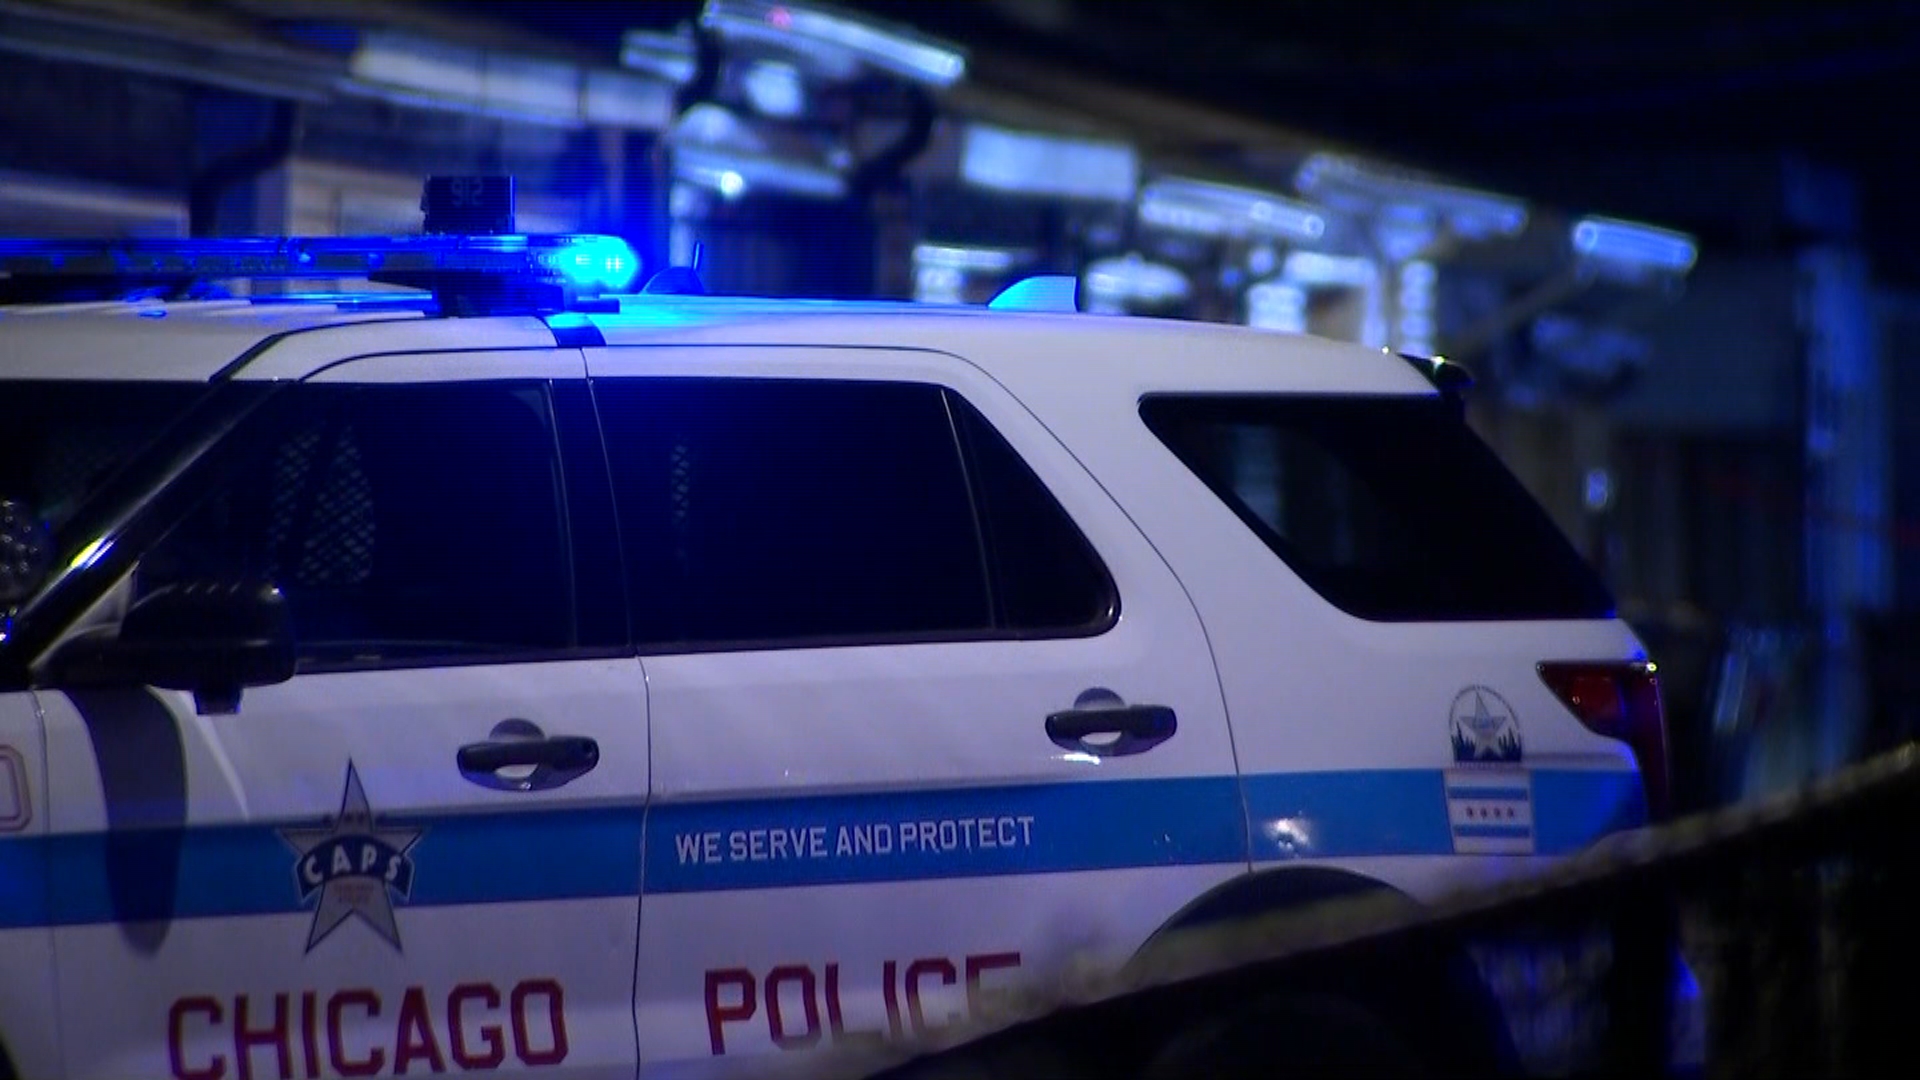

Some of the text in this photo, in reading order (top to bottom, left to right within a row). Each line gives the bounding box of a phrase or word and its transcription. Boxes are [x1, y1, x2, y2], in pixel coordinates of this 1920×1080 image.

[304, 843, 402, 884] CAPS
[675, 816, 1034, 865] WE SERVE AND PROTECT
[169, 979, 568, 1080] CHICAGO
